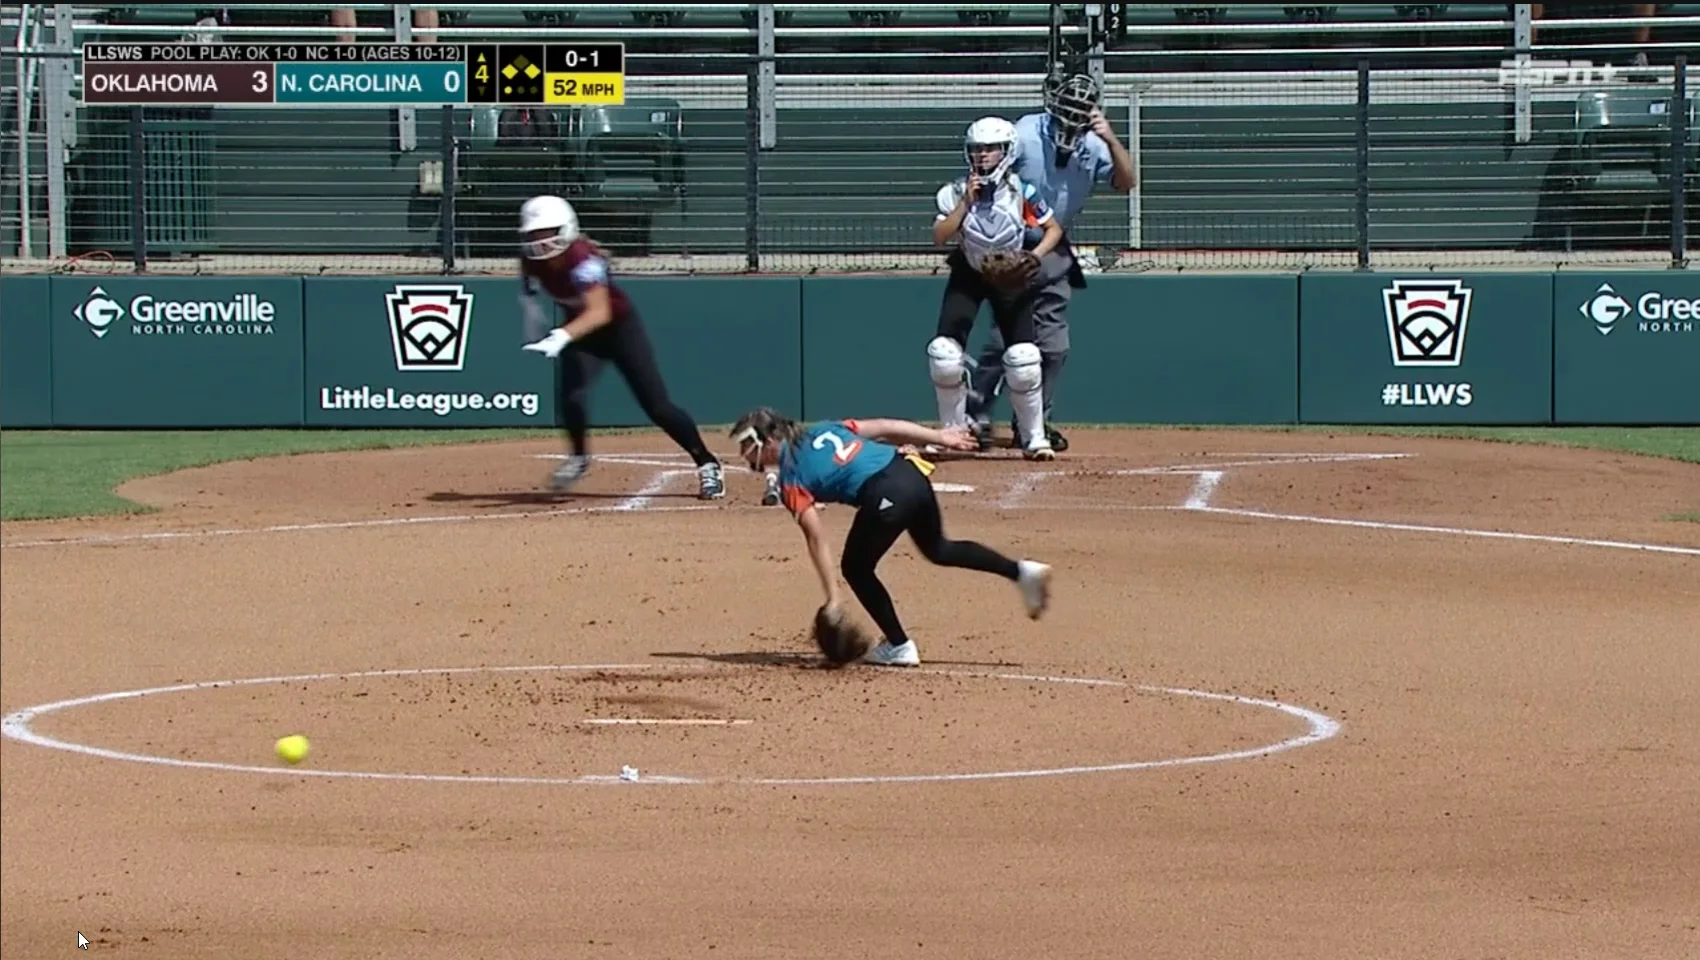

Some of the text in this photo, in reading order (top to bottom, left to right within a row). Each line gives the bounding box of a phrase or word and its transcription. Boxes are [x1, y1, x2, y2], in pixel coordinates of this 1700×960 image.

[130, 293, 275, 323] Greenville
[132, 324, 274, 335] NORTH CAROLINA
[1639, 321, 1692, 332] NORTH
[321, 385, 539, 416] LittleLeague.org
[1382, 383, 1473, 406] #LLWS
[812, 430, 864, 465] 2
